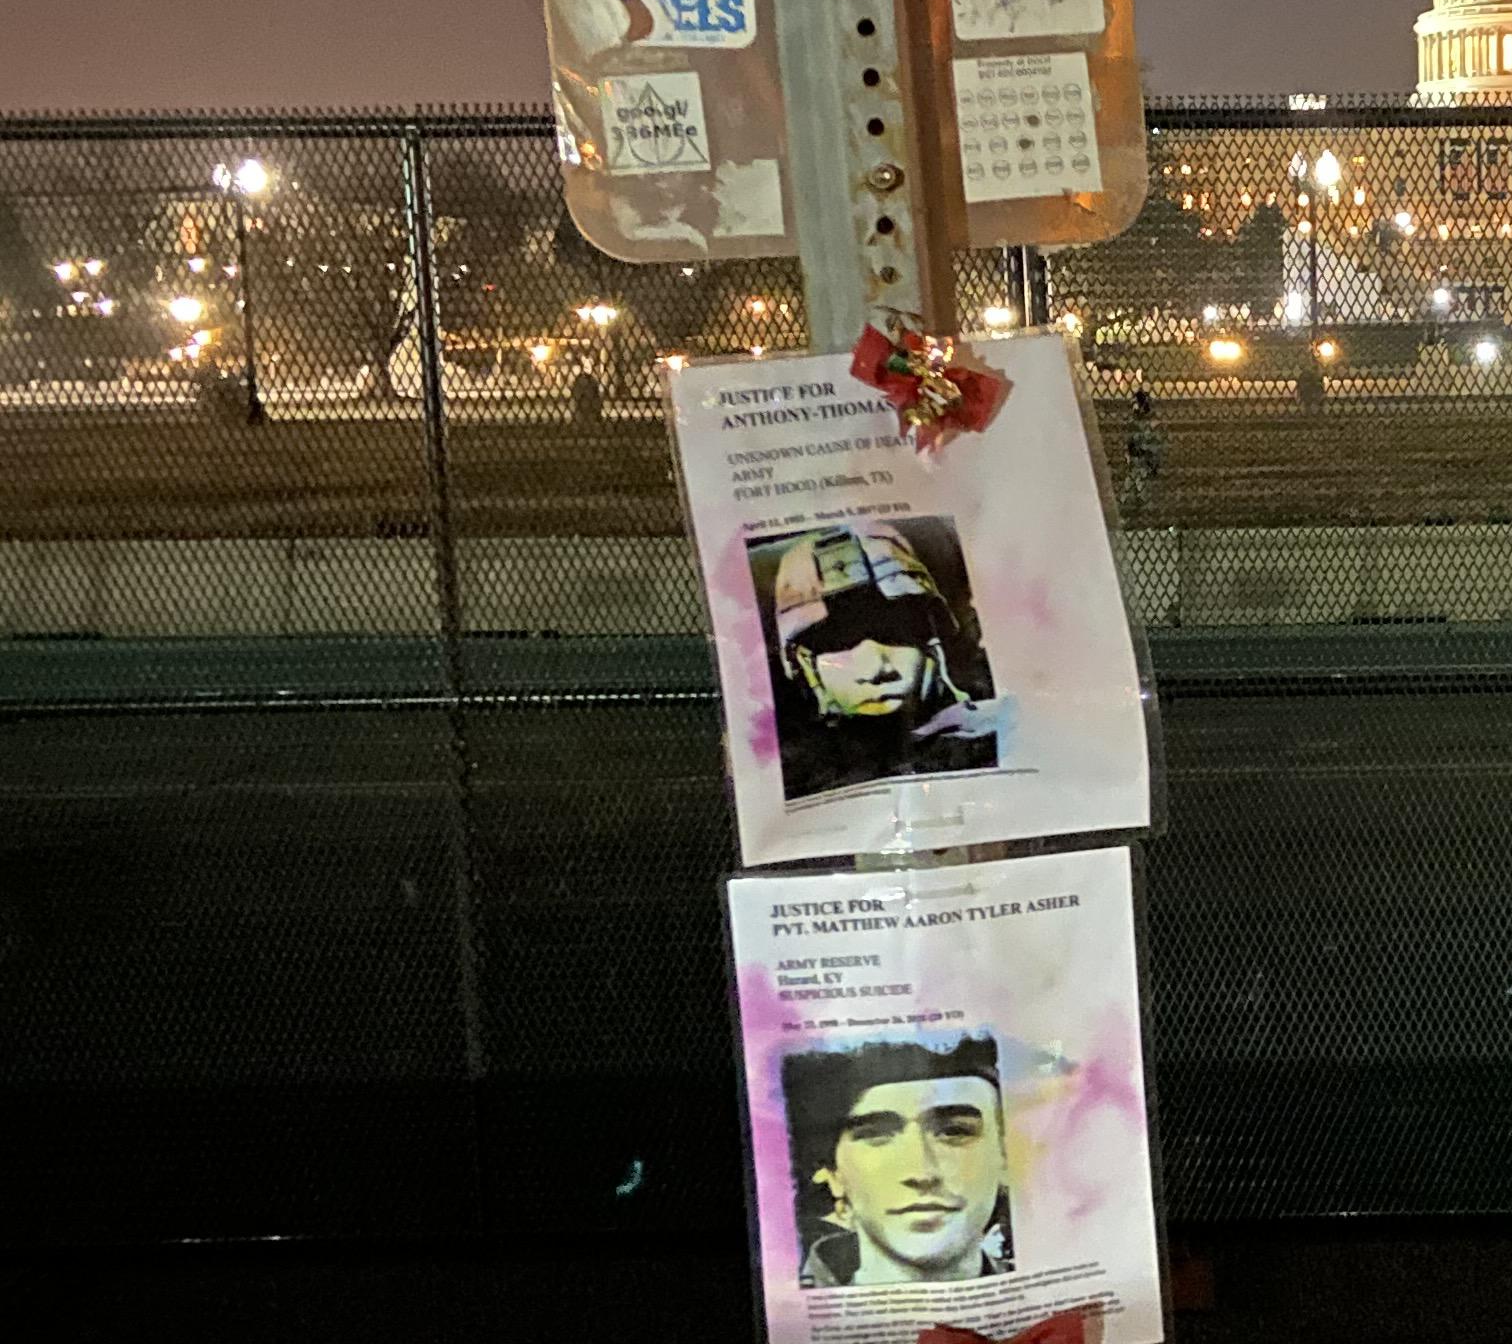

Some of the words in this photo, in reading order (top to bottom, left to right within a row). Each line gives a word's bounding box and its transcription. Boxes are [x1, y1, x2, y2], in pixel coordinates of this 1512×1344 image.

[719, 386, 793, 406] JUSTICE
[799, 382, 835, 401] FOR
[727, 443, 803, 465] UNKNOWN
[804, 438, 851, 456] CAUSE
[732, 467, 774, 483] ARMY
[770, 900, 844, 918] JUSTICE
[848, 898, 885, 914] FOR
[772, 920, 809, 937] PVT.
[812, 915, 901, 935] MATTHEW
[902, 909, 963, 930] AARON
[967, 902, 1022, 924] TYLER
[1026, 894, 1080, 914] ASHER
[776, 958, 817, 972] ARMY
[820, 954, 881, 970] RESERVE
